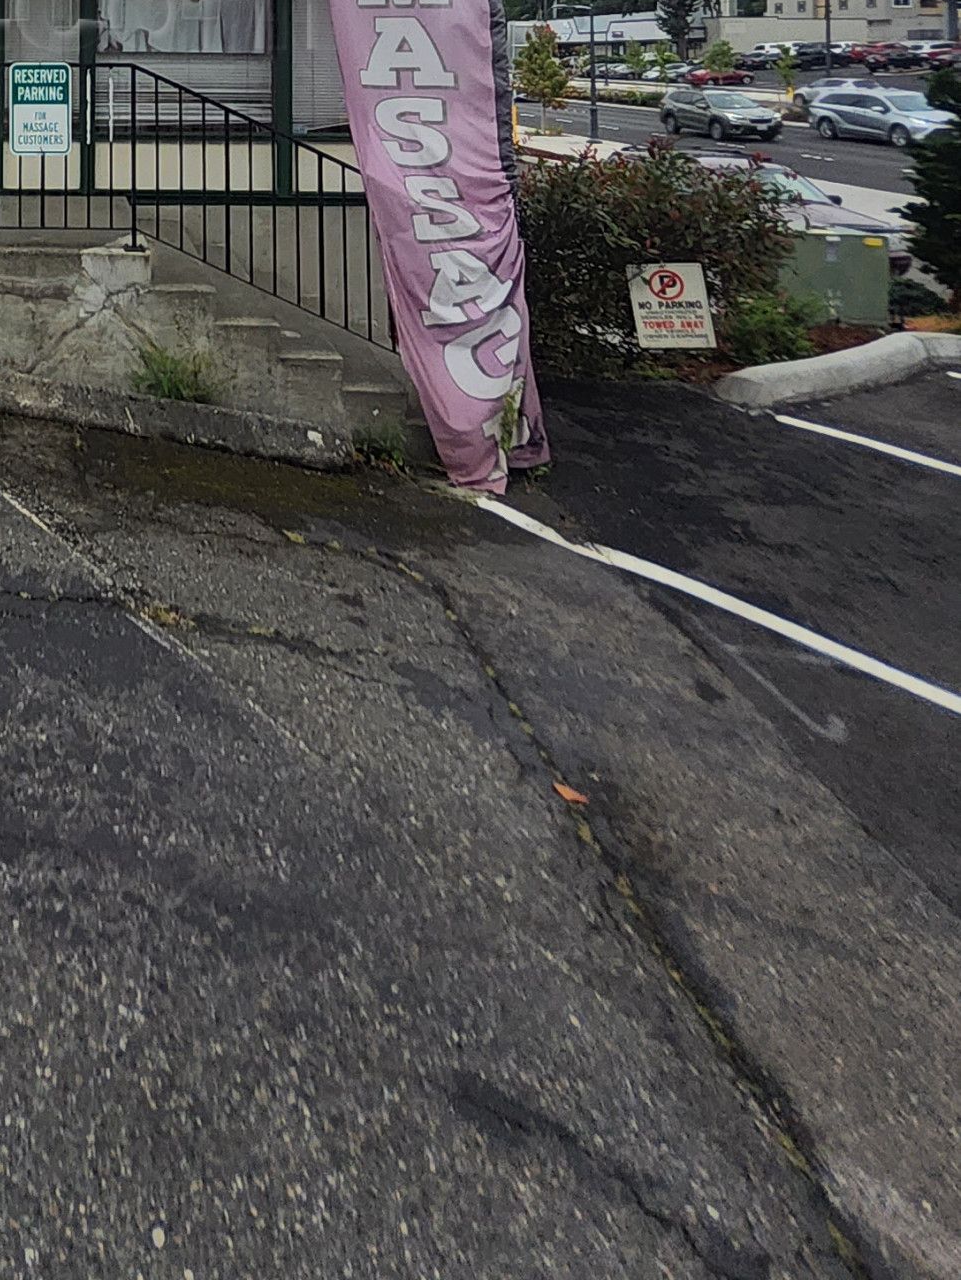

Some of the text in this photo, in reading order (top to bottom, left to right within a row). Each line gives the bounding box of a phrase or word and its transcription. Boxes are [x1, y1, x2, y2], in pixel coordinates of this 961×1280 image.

[14, 69, 67, 84] RESERVED
[18, 86, 64, 101] PARKING
[34, 111, 46, 120] FOR
[23, 123, 59, 132] MASSAGE
[18, 135, 64, 145] CUSTOMERS
[638, 301, 703, 310] NO PARKING
[642, 321, 704, 329] TOWED AWAY
